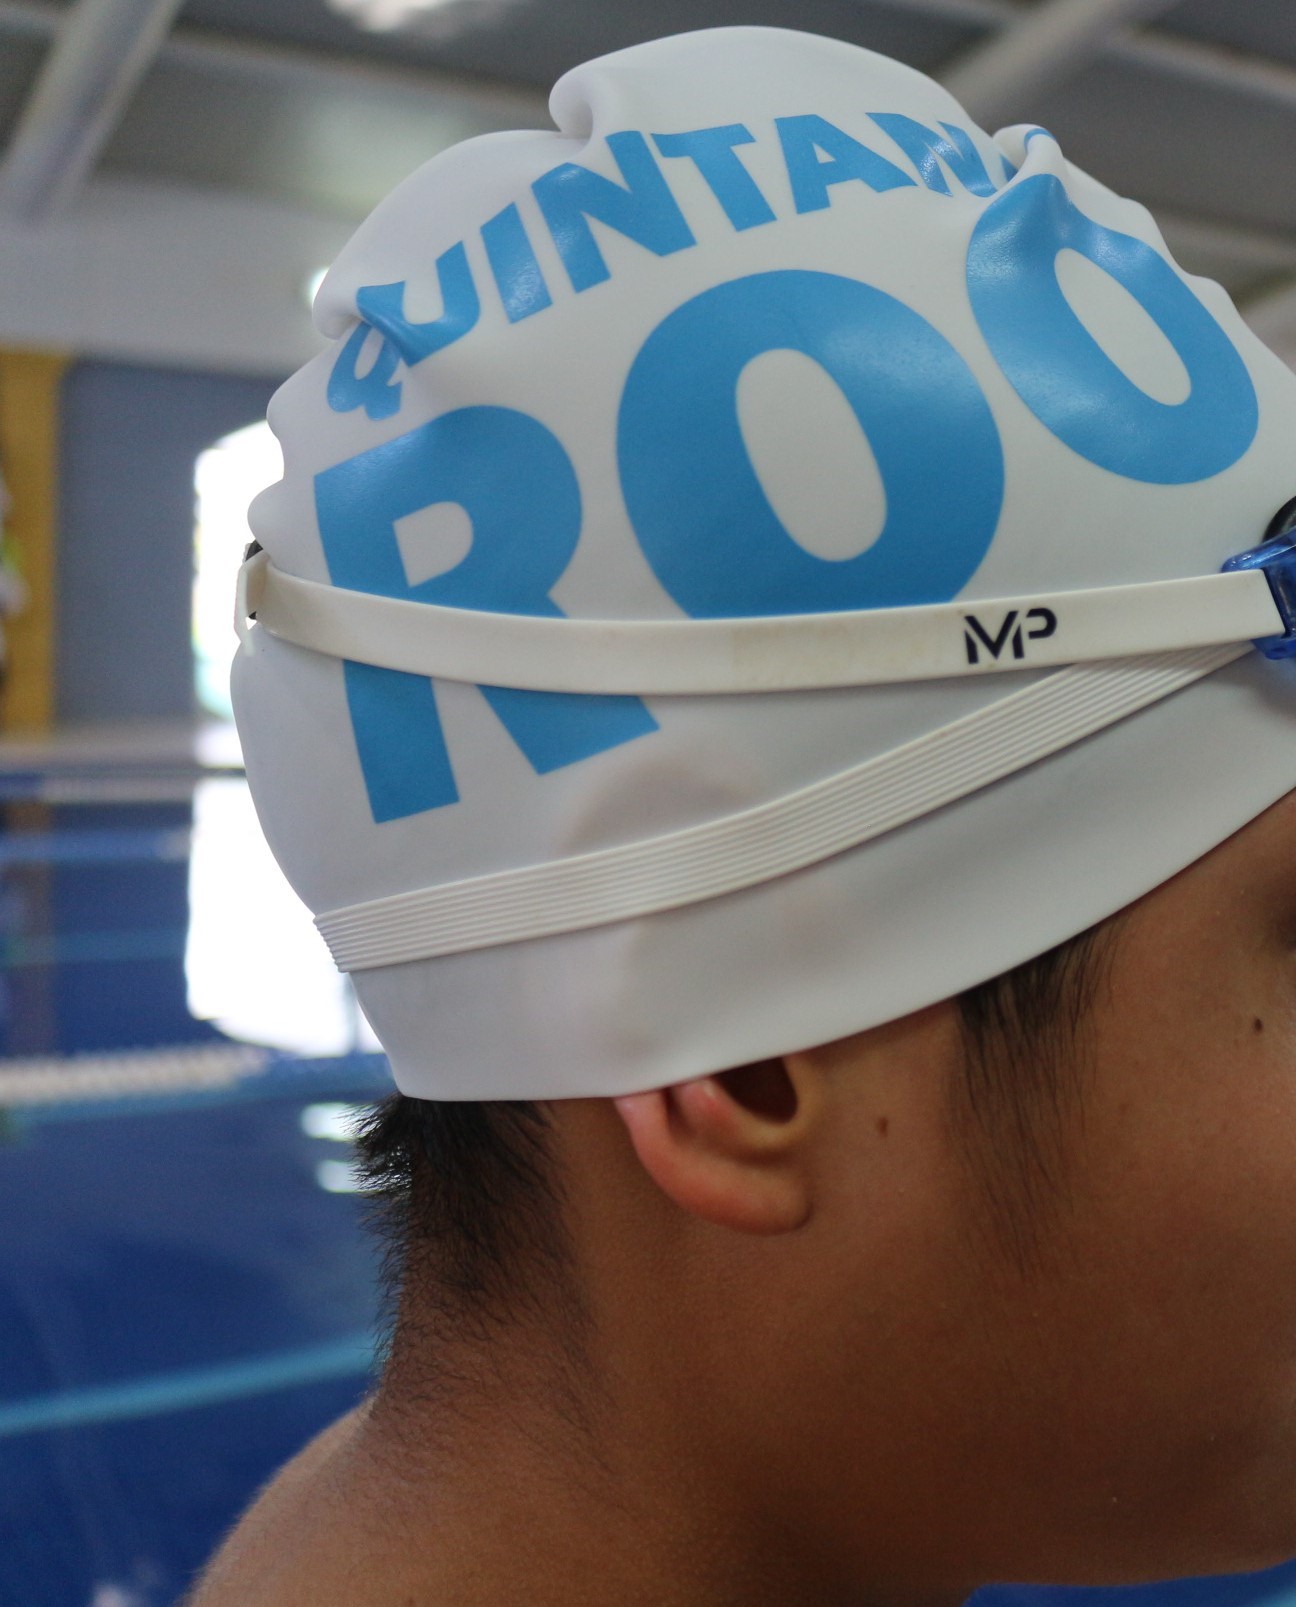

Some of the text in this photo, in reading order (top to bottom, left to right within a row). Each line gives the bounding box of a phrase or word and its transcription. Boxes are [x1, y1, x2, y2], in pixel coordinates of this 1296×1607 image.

[326, 112, 1056, 421] QUINTAN
[313, 173, 1259, 824] ROO
[963, 607, 1058, 665] MP
